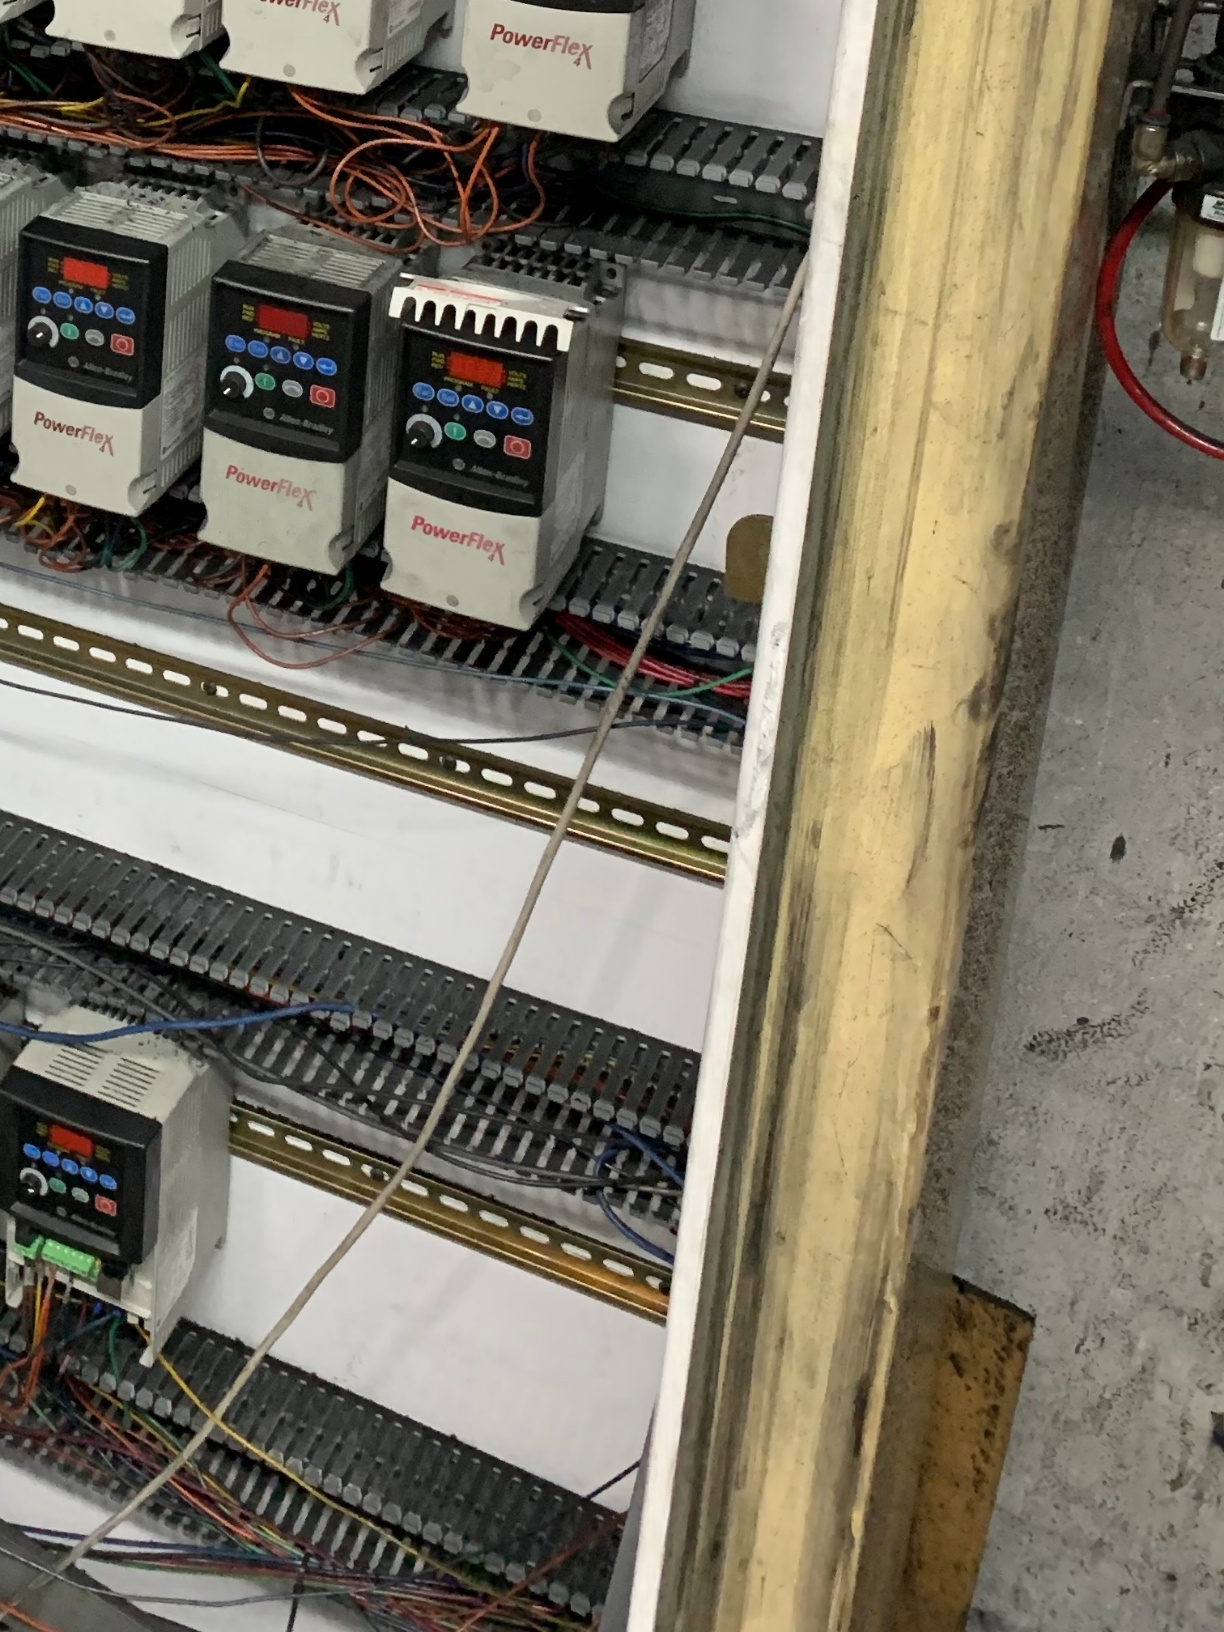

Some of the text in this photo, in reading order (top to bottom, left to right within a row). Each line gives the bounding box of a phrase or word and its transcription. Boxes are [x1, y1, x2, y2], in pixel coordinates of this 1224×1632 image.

[490, 23, 593, 70] PowerFlex
[33, 411, 114, 457] PowerFlex
[225, 464, 317, 512] PowerFlex
[410, 514, 505, 566] PowerFlex
